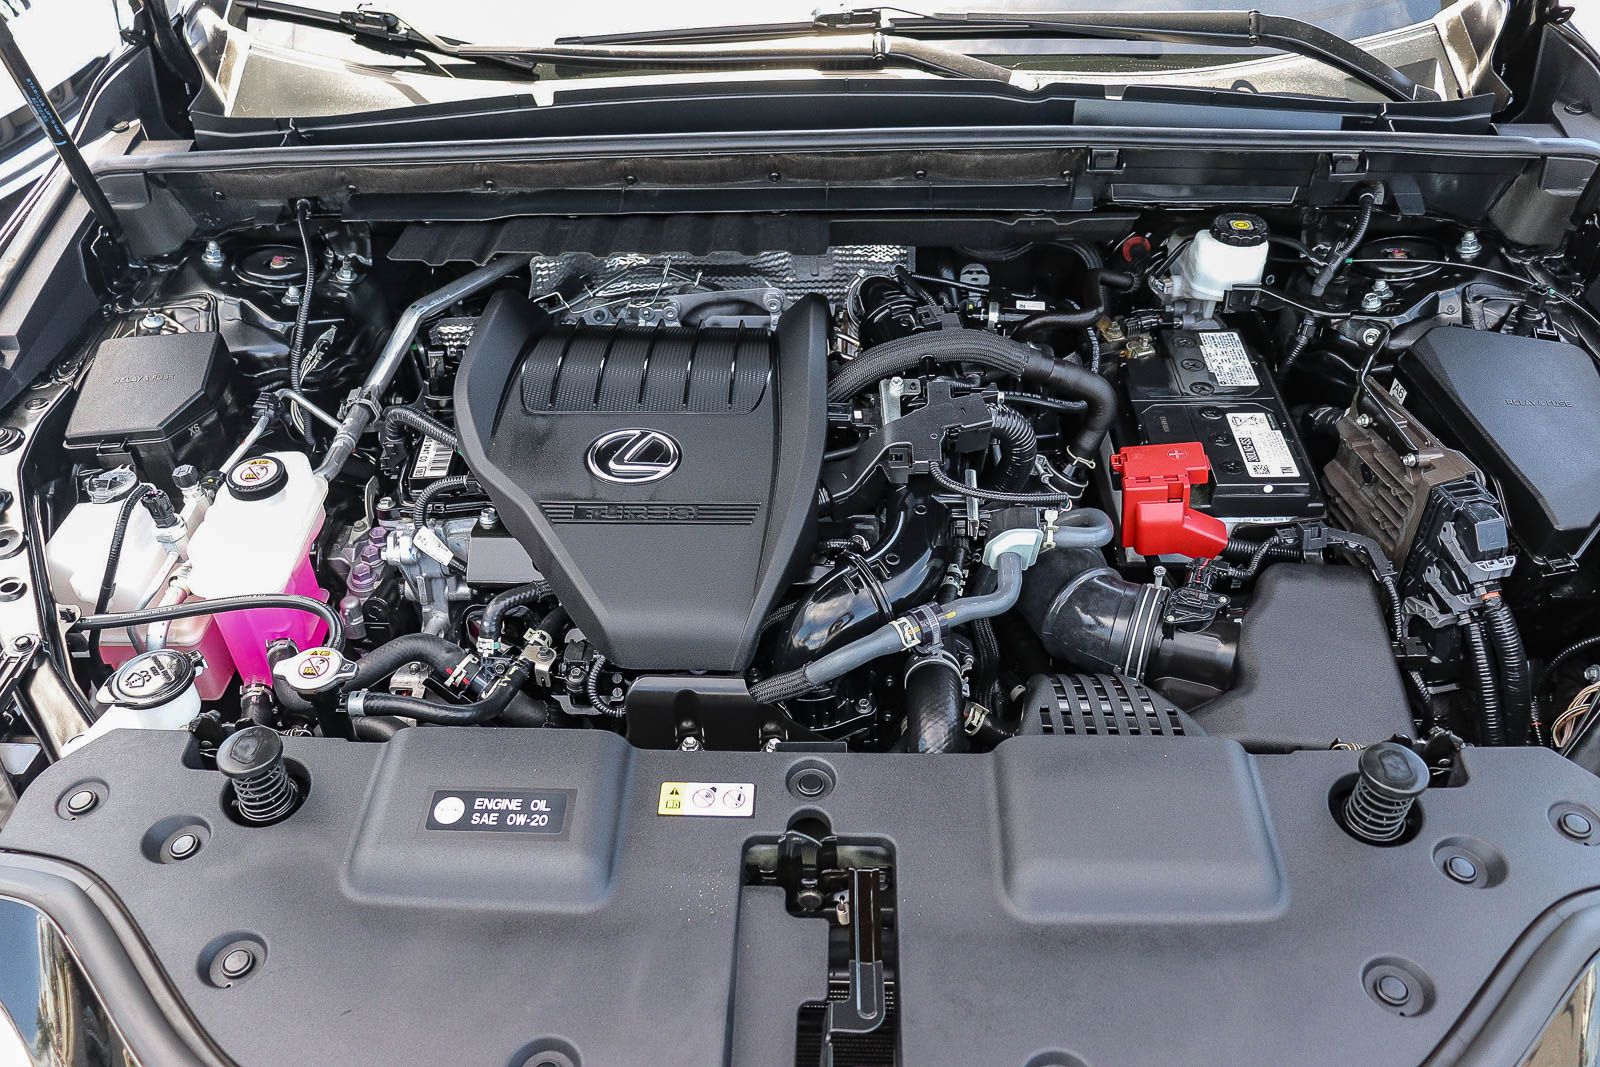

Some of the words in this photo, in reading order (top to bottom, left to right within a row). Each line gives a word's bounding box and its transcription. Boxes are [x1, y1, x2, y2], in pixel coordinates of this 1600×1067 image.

[113, 375, 144, 384] RELAY
[151, 373, 176, 381] FUSE
[1392, 383, 1404, 399] A6
[188, 423, 200, 437] XS
[582, 505, 699, 520] TURBO
[473, 798, 523, 810] ENGINE
[530, 799, 551, 811] OIL
[471, 813, 499, 825] SAE
[506, 813, 549, 826] 0W-20
